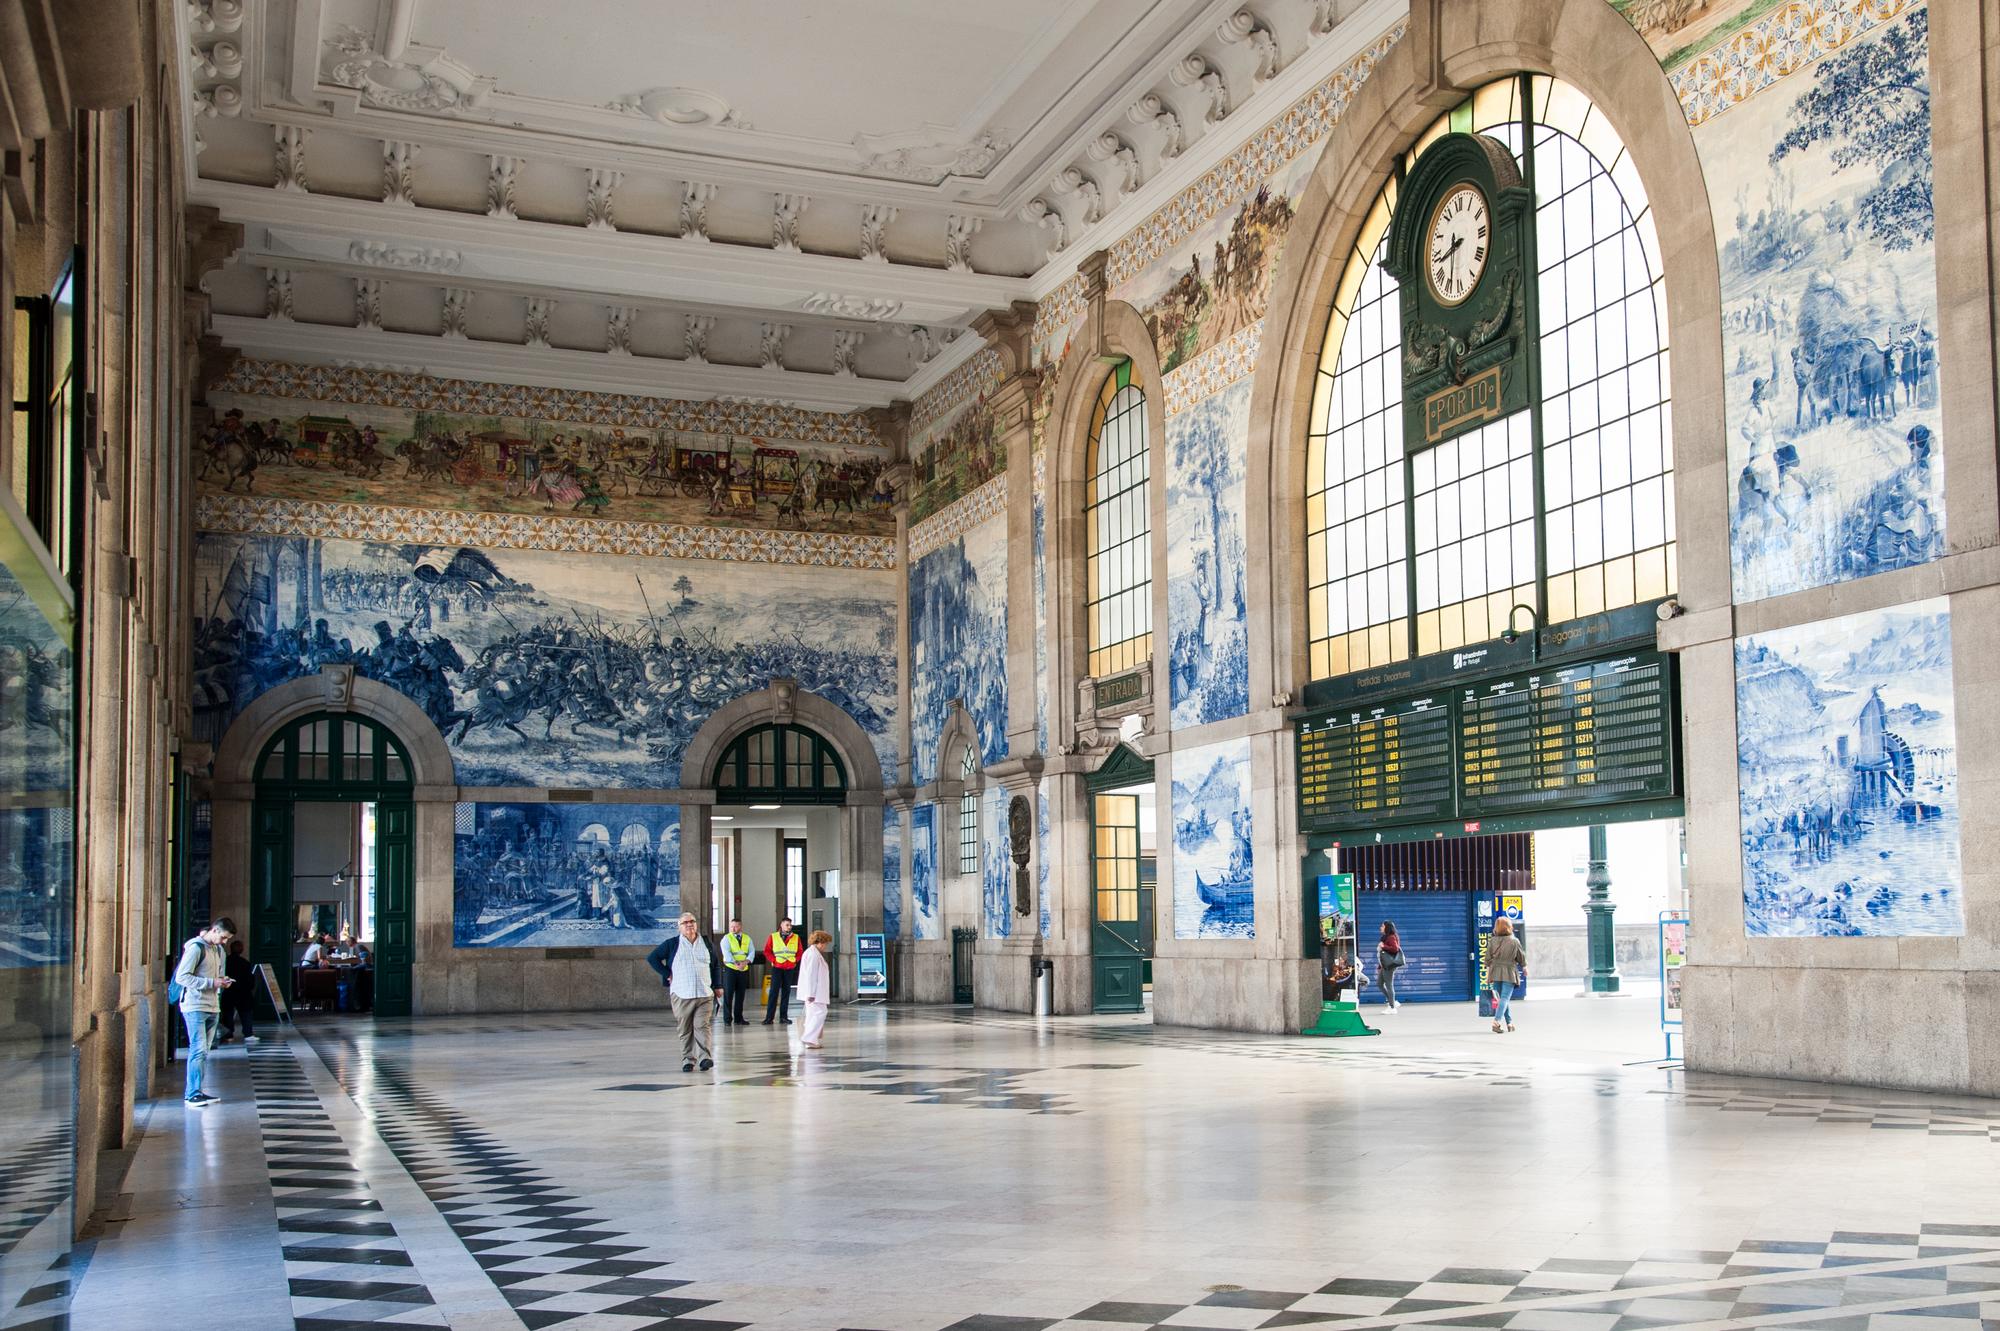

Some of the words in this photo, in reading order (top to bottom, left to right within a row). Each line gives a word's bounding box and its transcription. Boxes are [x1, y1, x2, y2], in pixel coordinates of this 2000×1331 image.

[1437, 380, 1487, 424] PORTO
[1541, 627, 1583, 645] Chegadas
[1100, 677, 1140, 705] ENTRADA
[1575, 719, 1593, 731] 15512
[1479, 932, 1489, 991] EXCHANGE
